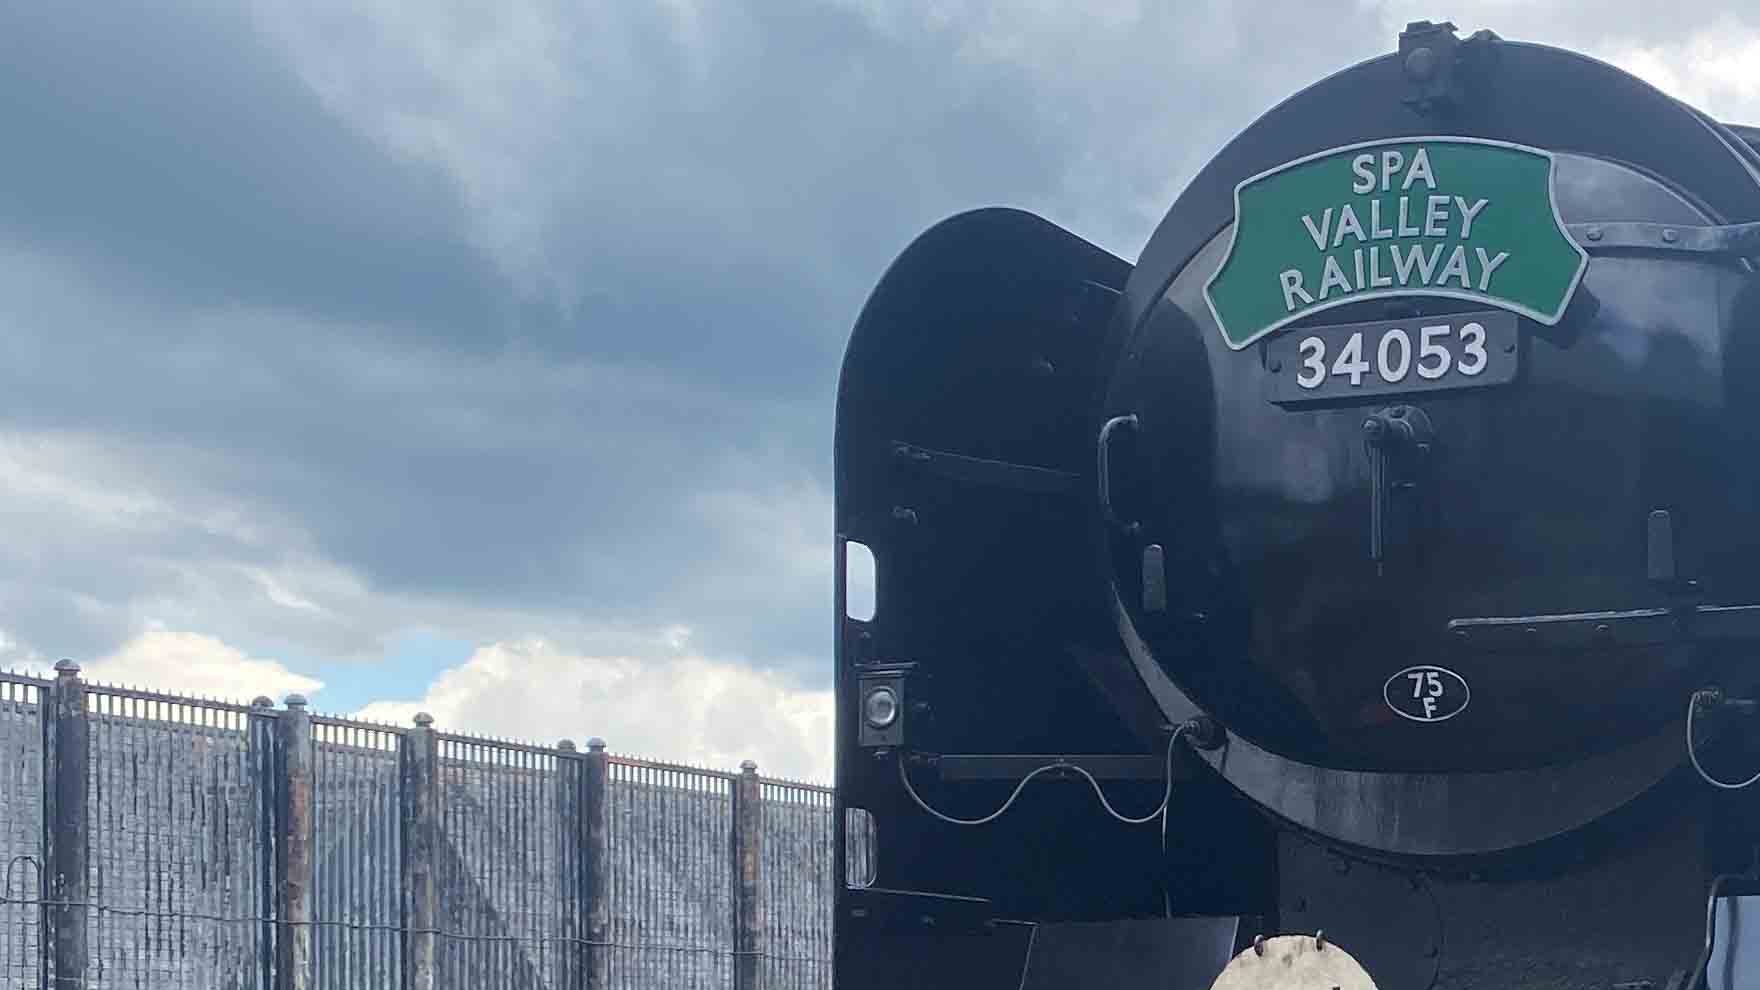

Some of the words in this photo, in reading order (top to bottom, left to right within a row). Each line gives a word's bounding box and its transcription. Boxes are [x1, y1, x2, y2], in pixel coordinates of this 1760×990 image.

[1352, 145, 1437, 195] SPA
[1302, 195, 1489, 251] VALLEY
[1280, 243, 1511, 311] RAILWAY
[1296, 322, 1488, 389] 34053
[1407, 672, 1443, 698] 75
[1423, 697, 1437, 718] F
